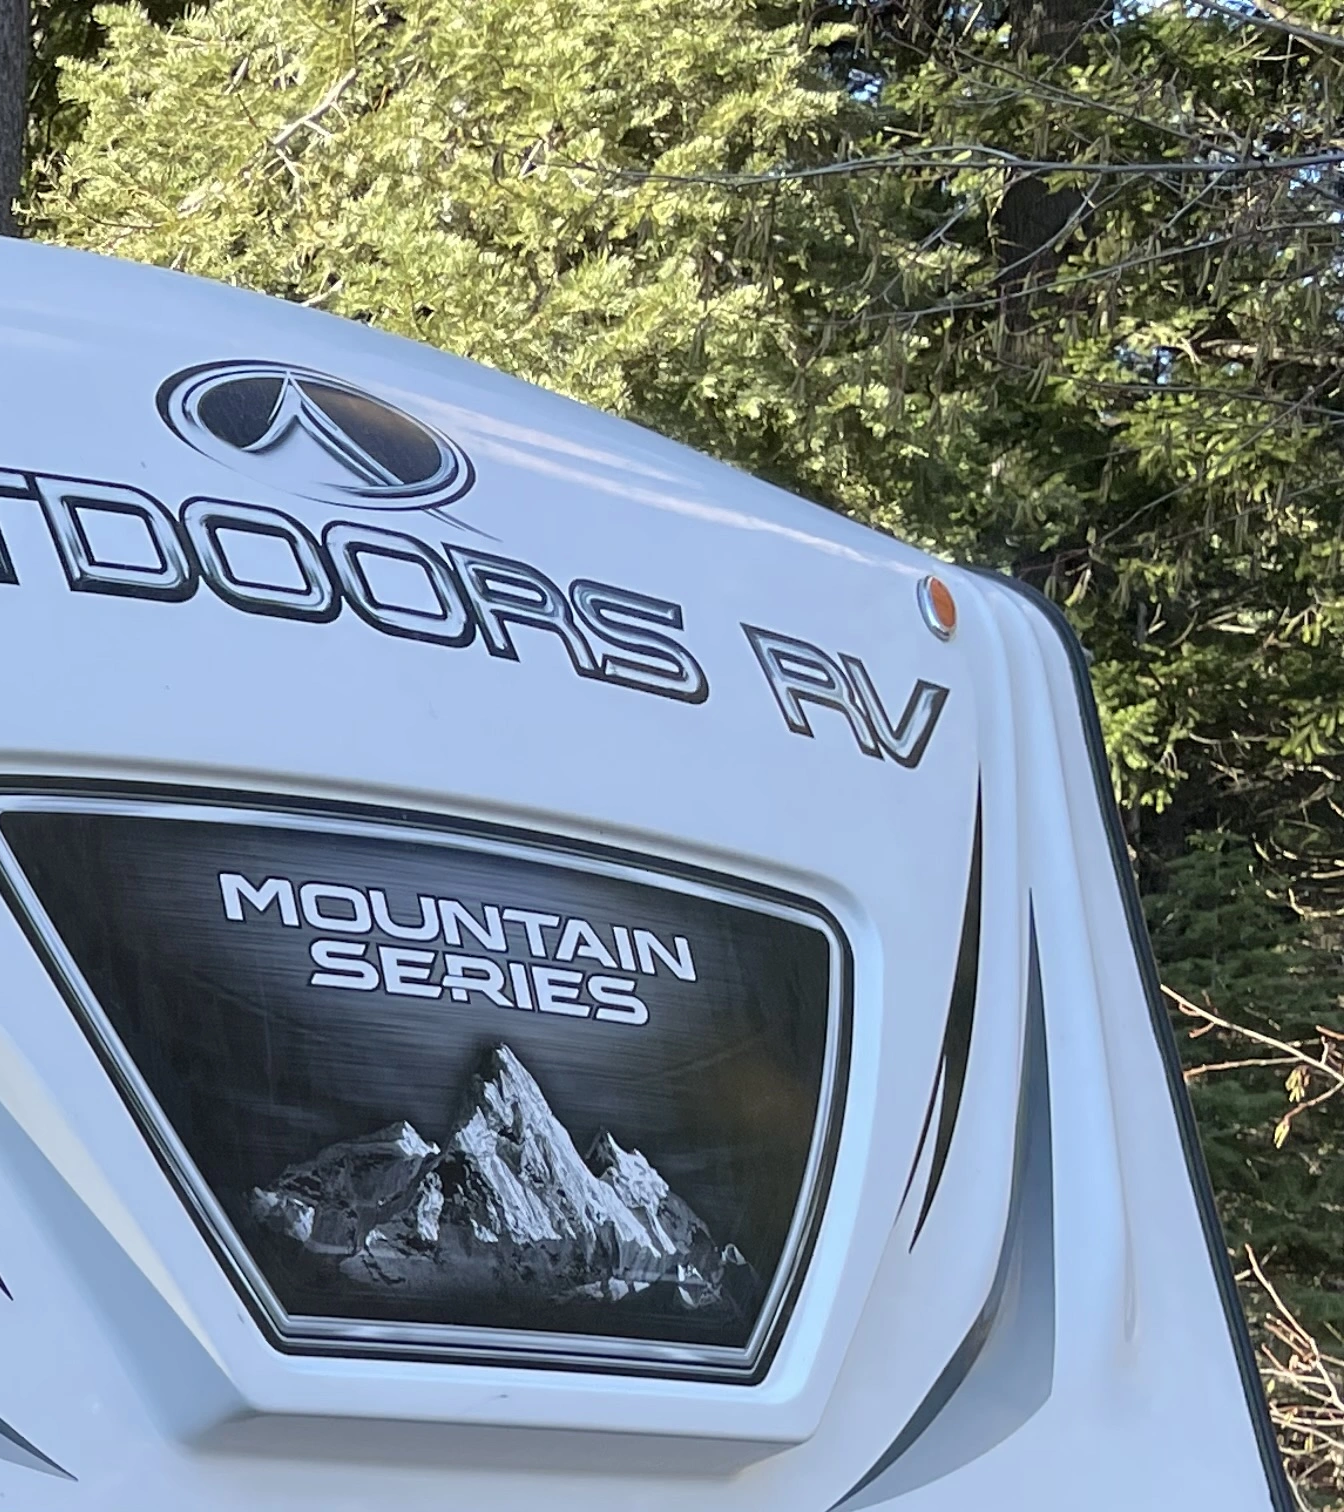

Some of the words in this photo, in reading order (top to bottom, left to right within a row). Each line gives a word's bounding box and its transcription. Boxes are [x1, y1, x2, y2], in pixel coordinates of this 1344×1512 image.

[740, 622, 950, 769] RV
[217, 871, 698, 982] MOUNTAIN
[309, 937, 650, 1026] SERIES
